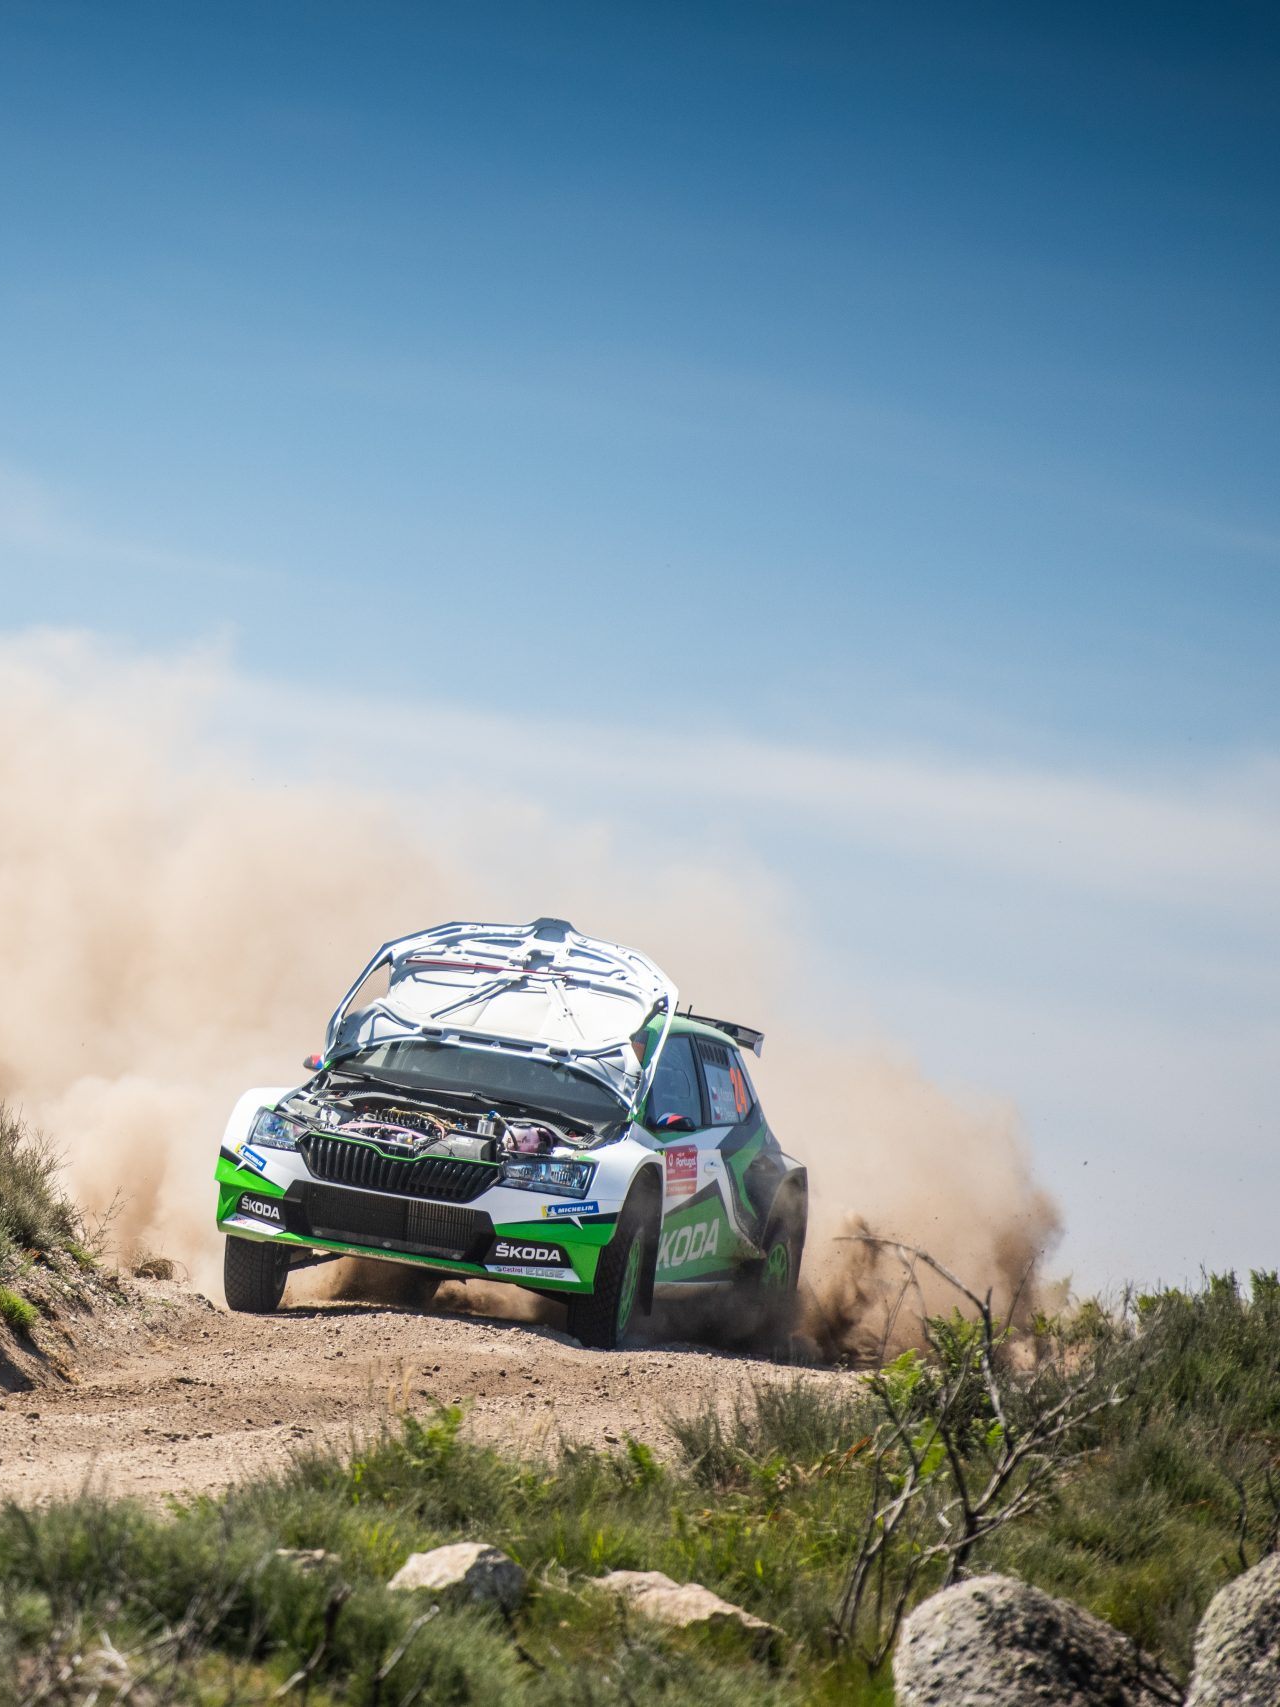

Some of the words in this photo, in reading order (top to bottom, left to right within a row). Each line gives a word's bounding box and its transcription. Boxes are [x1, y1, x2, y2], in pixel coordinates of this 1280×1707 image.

[729, 1067, 749, 1116] 24
[675, 1155, 696, 1168] Portugal
[241, 1195, 280, 1220] ŠKODA
[557, 1204, 594, 1214] MICHELIN
[495, 1242, 561, 1262] ŠKODA
[656, 1217, 720, 1272] KODA
[525, 1267, 566, 1279] EDGE
